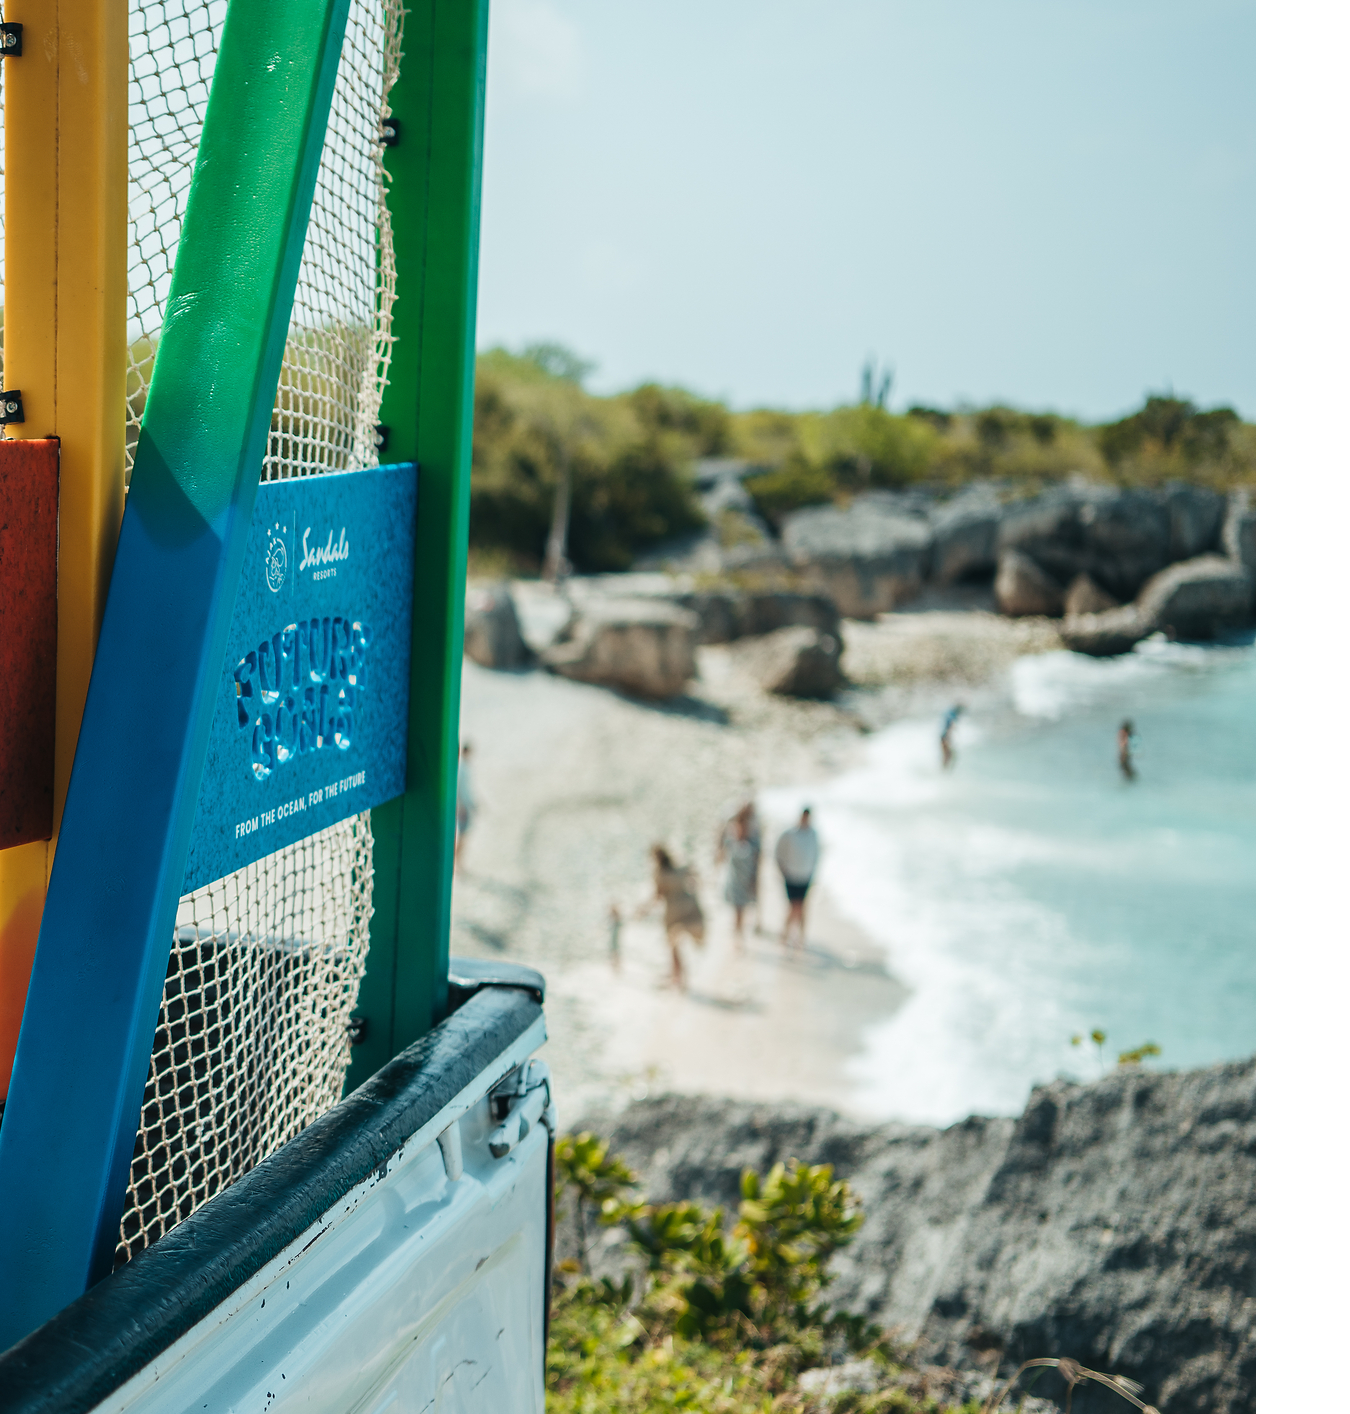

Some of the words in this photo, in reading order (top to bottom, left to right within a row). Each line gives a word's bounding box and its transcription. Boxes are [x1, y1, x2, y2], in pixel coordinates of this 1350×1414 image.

[299, 526, 349, 571] Sandals
[313, 567, 337, 581] RESORTS
[235, 816, 259, 839] FROM
[261, 809, 276, 828] THE
[277, 796, 307, 820] OCEAN,
[309, 789, 324, 806] FOR
[324, 782, 338, 799] THE
[339, 770, 366, 793] FUTURE
